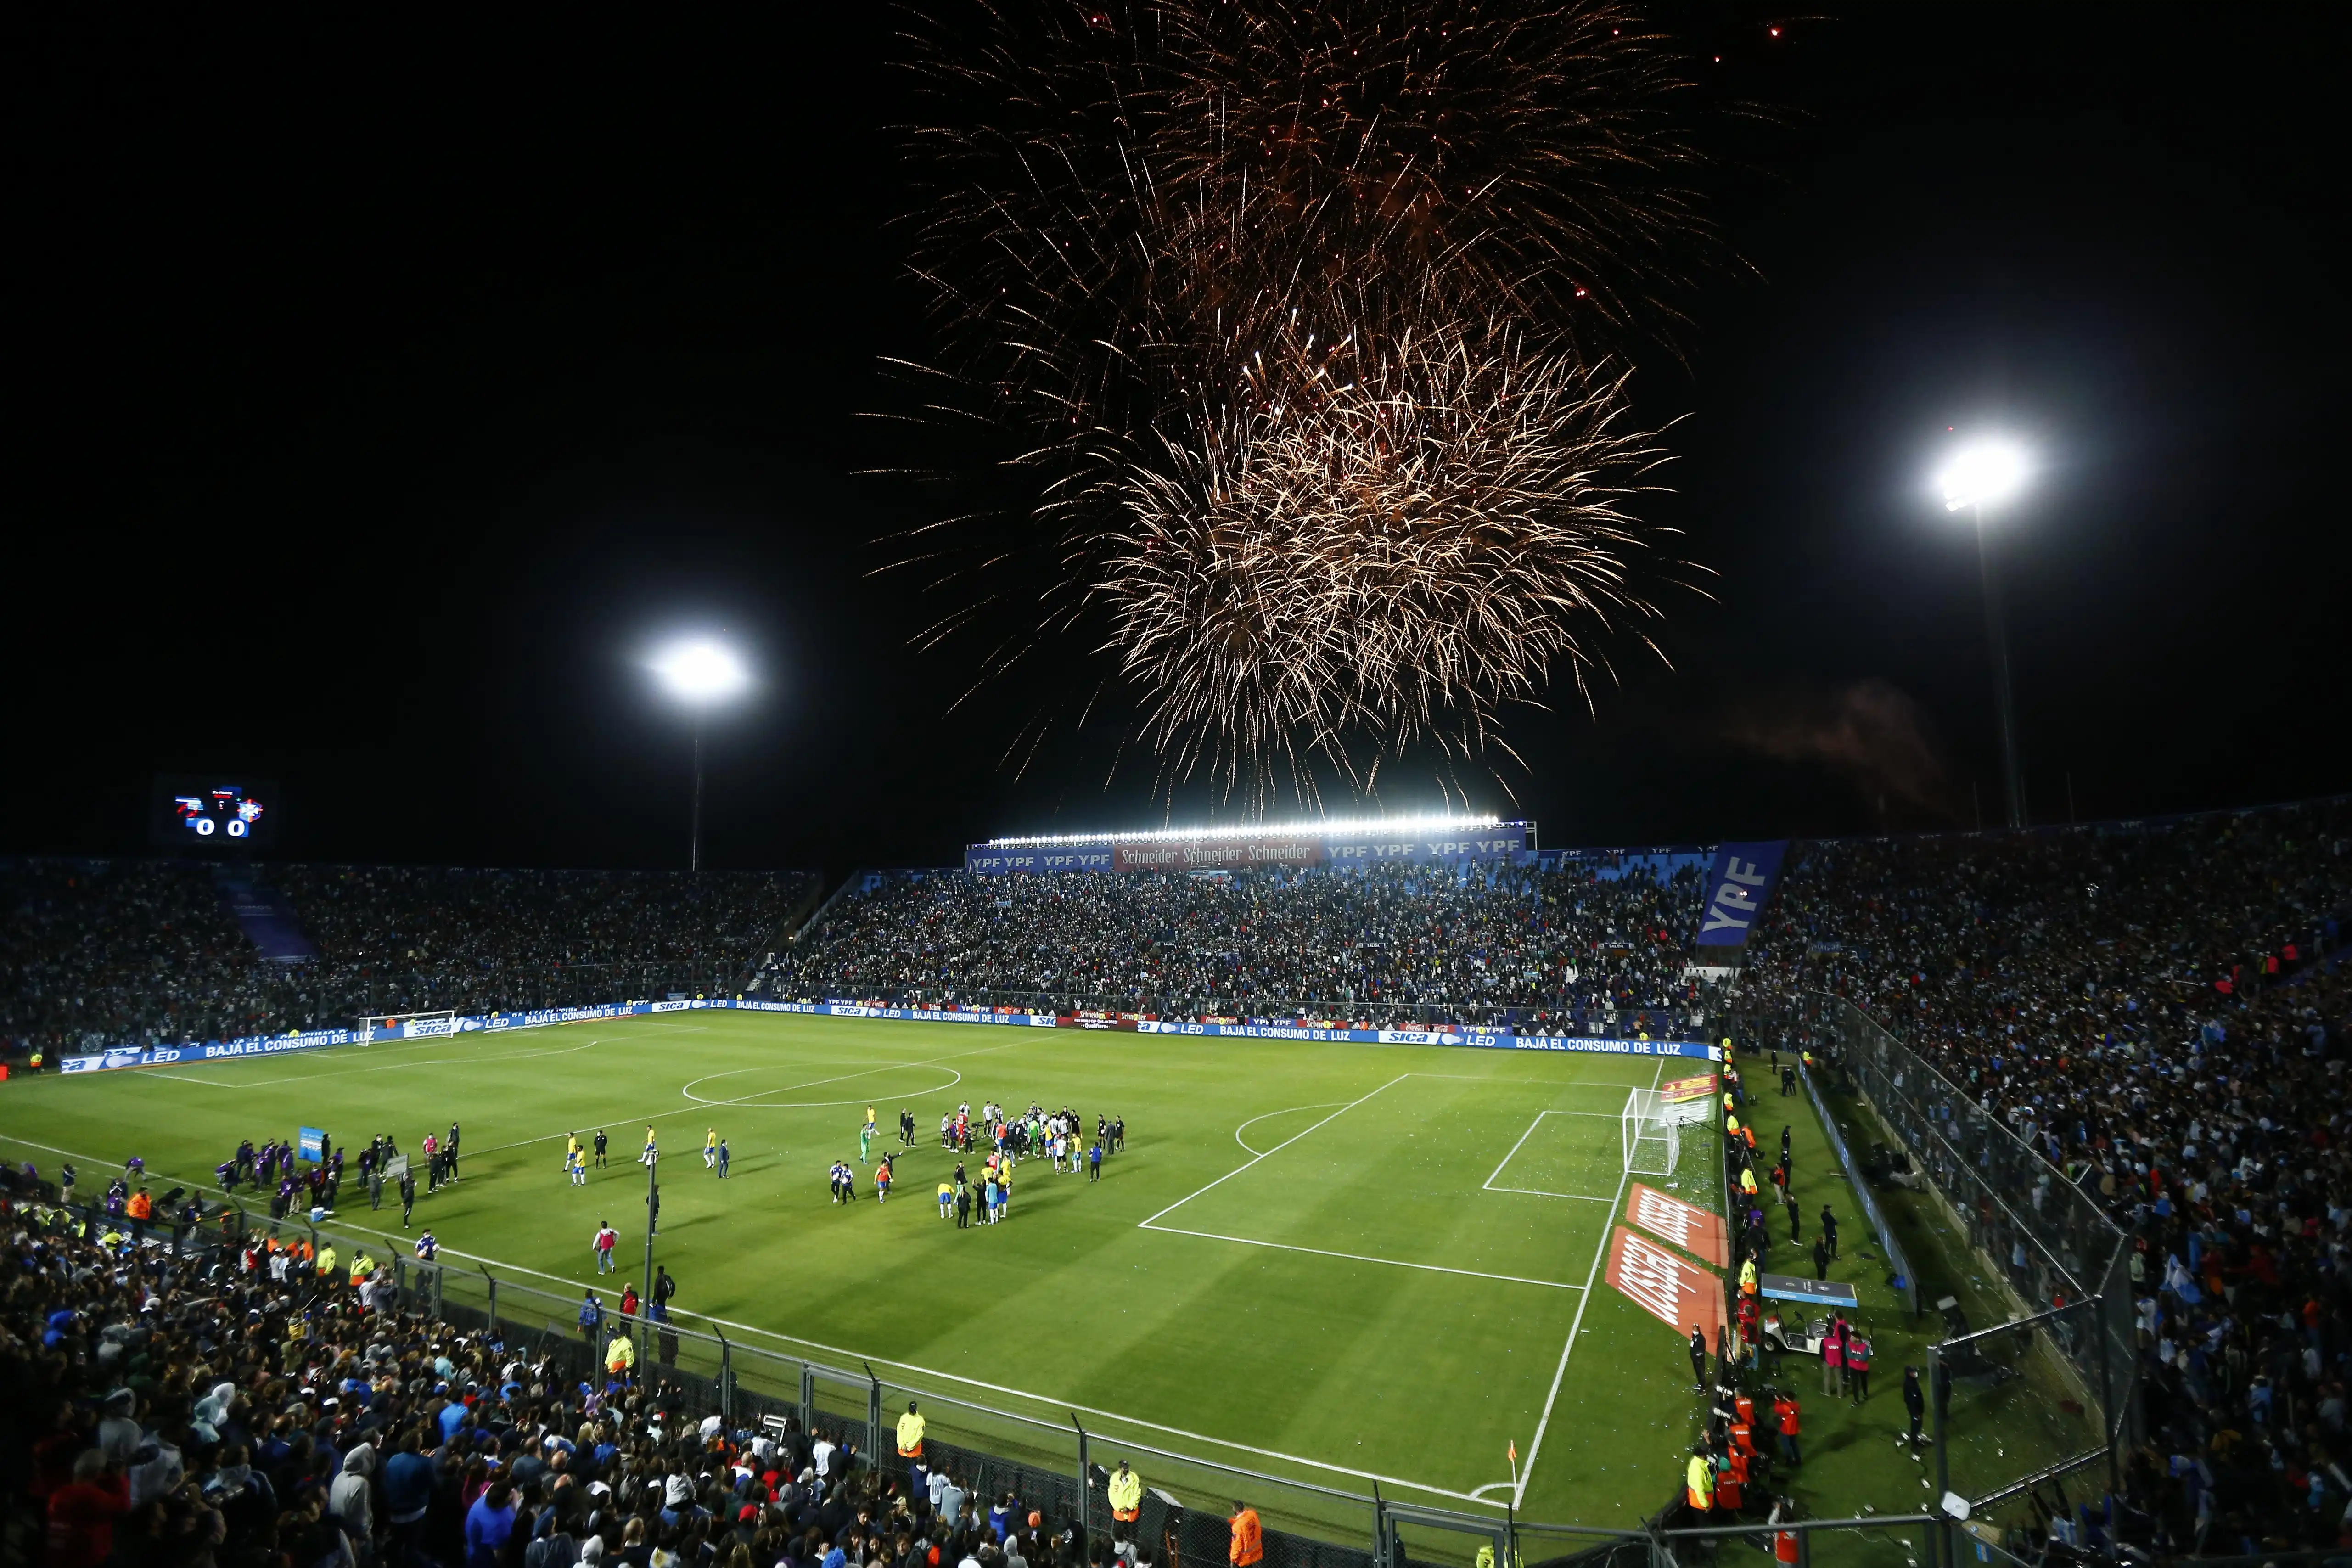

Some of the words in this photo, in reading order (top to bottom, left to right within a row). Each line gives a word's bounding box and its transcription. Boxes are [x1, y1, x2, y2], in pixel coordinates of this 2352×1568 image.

[196, 819, 215, 835] 0
[228, 821, 245, 836] 0
[1122, 849, 1178, 864] Schneider
[1184, 846, 1242, 863] Schneider
[1249, 844, 1310, 860] Schneider
[1329, 846, 1367, 858] YPF
[1373, 844, 1414, 856] YPF
[1428, 842, 1470, 855] YPF
[1476, 840, 1520, 853] YPF
[972, 858, 1000, 869] YPF
[1004, 857, 1034, 867] YPF
[1044, 855, 1074, 867] YPF
[1078, 854, 1110, 865] YPF
[1702, 856, 1765, 933] YPF
[710, 1000, 727, 1008] LED
[736, 1000, 752, 1009] BAJÁ
[761, 1002, 791, 1012] CONSUMO
[803, 1005, 815, 1013] LUZ
[485, 1018, 509, 1029] LED
[525, 1012, 548, 1024] BAJÁ
[550, 1012, 561, 1022] EL
[562, 1009, 602, 1021] CONSUMO
[605, 1006, 615, 1017] DE
[618, 1006, 633, 1015] LUZ
[883, 1009, 901, 1018] LED
[913, 1009, 931, 1020] BAJÁ
[933, 1012, 942, 1020] EL
[942, 1012, 979, 1023] CONSUMO
[982, 1014, 992, 1023] DE
[995, 1015, 1009, 1023] LUZ
[1180, 1024, 1204, 1034] LED
[1220, 1024, 1245, 1036] BAJÁ
[1247, 1027, 1258, 1037] EL
[1260, 1028, 1309, 1040] CONSUMO
[1313, 1030, 1326, 1040] DE
[1331, 1031, 1350, 1041] LUZ
[141, 1051, 181, 1064] LED
[206, 1040, 243, 1057] BAJÁ
[246, 1042, 263, 1053] EL
[264, 1037, 327, 1051] CONSUMO
[331, 1033, 348, 1045] DE
[353, 1031, 375, 1042] LUZ
[1389, 1033, 1429, 1043] sica
[1466, 1036, 1496, 1046] LED
[1516, 1037, 1548, 1049] BAJÁ
[1550, 1038, 1565, 1050] EL
[1567, 1040, 1629, 1053] CONSUMO
[1634, 1042, 1651, 1054] DE
[1657, 1044, 1682, 1055] LUZ
[1637, 1188, 1706, 1247] betsson
[1618, 1234, 1700, 1326] betsson
